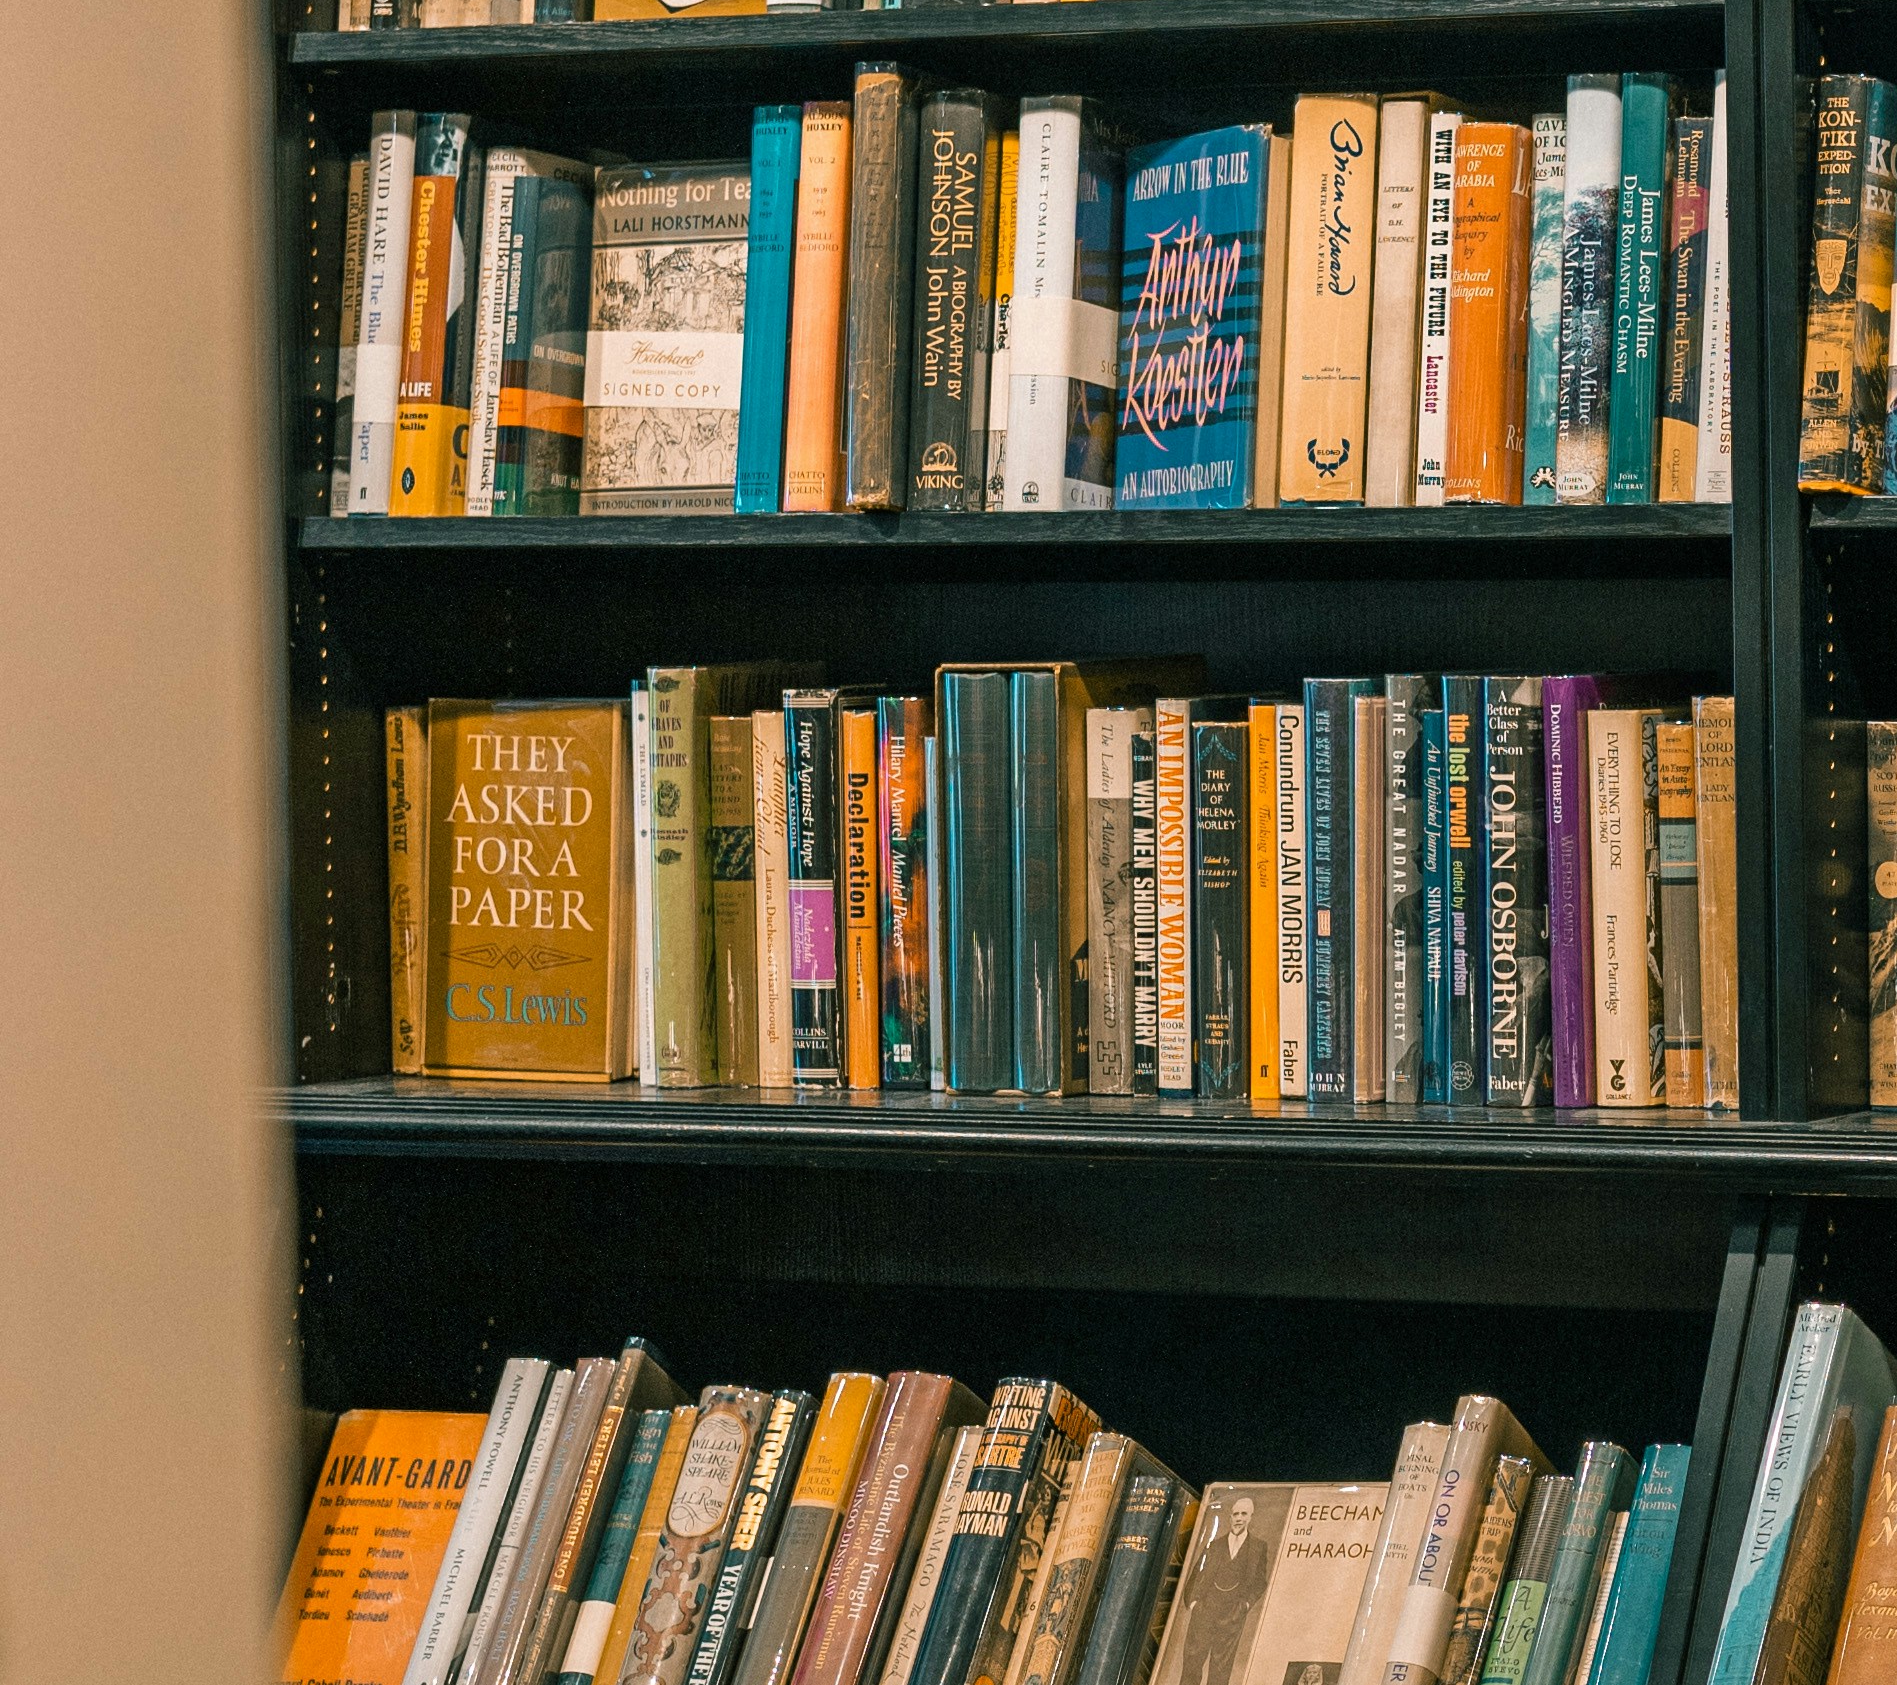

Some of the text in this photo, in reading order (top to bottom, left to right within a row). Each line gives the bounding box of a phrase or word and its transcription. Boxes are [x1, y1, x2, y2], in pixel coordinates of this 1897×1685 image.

[600, 180, 715, 208] Nothing for
[1132, 152, 1249, 201] ARROW IN THE BLUE
[614, 217, 645, 233] LALI
[410, 183, 436, 352] Chester Himes
[916, 475, 964, 489] VIKING
[1121, 460, 1234, 500] AN AUTOBIOGRAPHY
[467, 734, 573, 774] THEY
[445, 785, 593, 827] ASKED
[454, 836, 580, 878] FOR A
[847, 773, 868, 919] Declaration
[1278, 715, 1303, 984] Conundrum JAN MORRIS
[449, 888, 594, 931] PAPER
[1490, 765, 1518, 1059] JOHN OSBORNE
